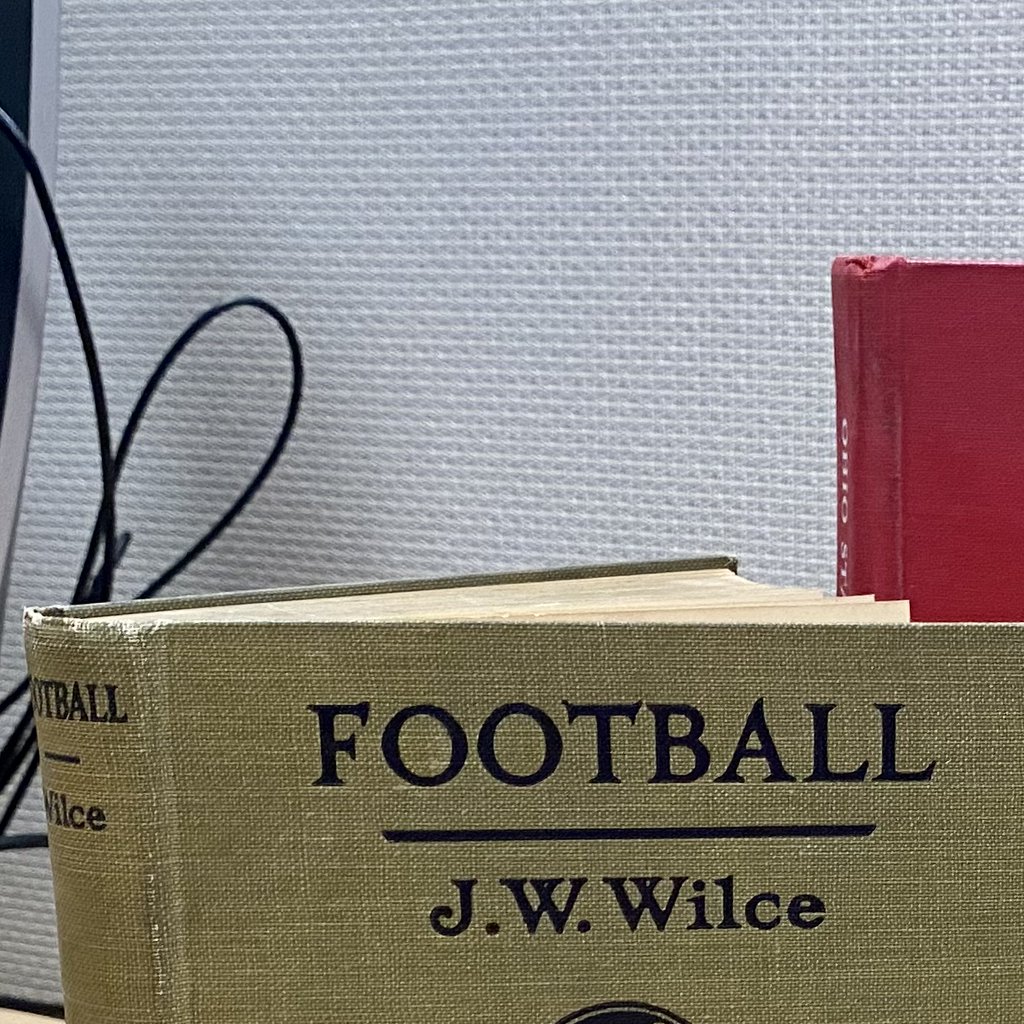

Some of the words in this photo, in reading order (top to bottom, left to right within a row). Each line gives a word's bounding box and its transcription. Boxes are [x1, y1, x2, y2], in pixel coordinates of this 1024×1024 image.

[307, 697, 938, 787] FOOTBALL
[430, 877, 591, 936] J.W.
[603, 875, 826, 932] Wilce
